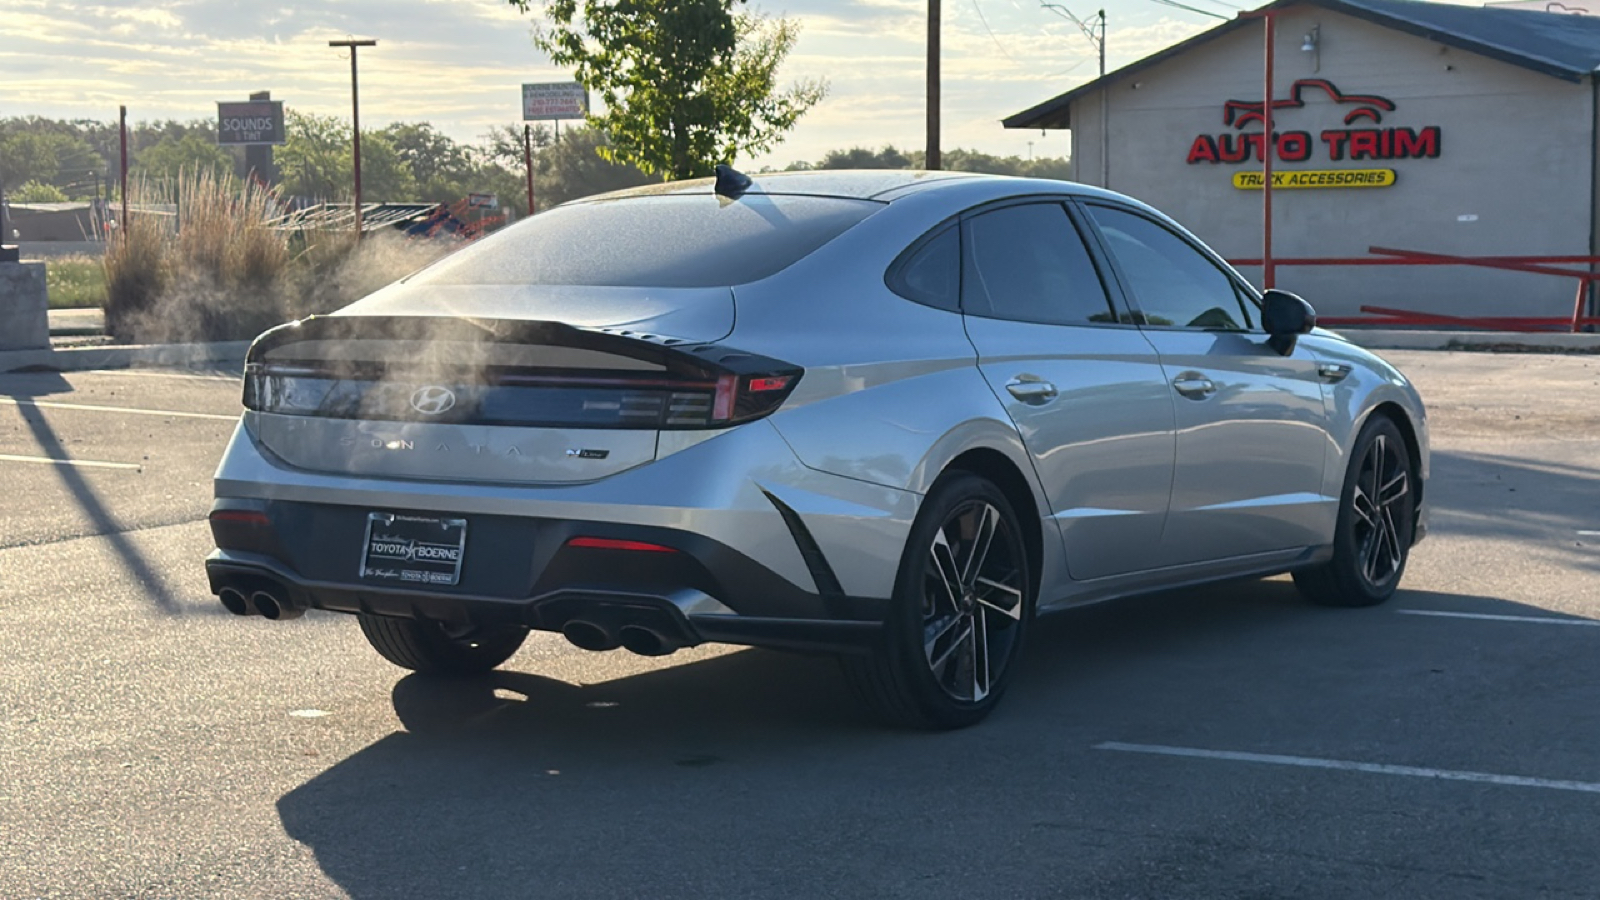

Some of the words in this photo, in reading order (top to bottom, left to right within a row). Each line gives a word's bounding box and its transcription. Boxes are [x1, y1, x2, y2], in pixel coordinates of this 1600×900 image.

[223, 117, 272, 131] SOUNDS
[1186, 131, 1312, 163] AUTO
[1321, 126, 1441, 160] TRIM
[1289, 171, 1386, 185] ACCESSORIES
[339, 437, 521, 456] SONATA
[371, 542, 406, 555] TOYOTA
[418, 546, 460, 560] BOERNE
